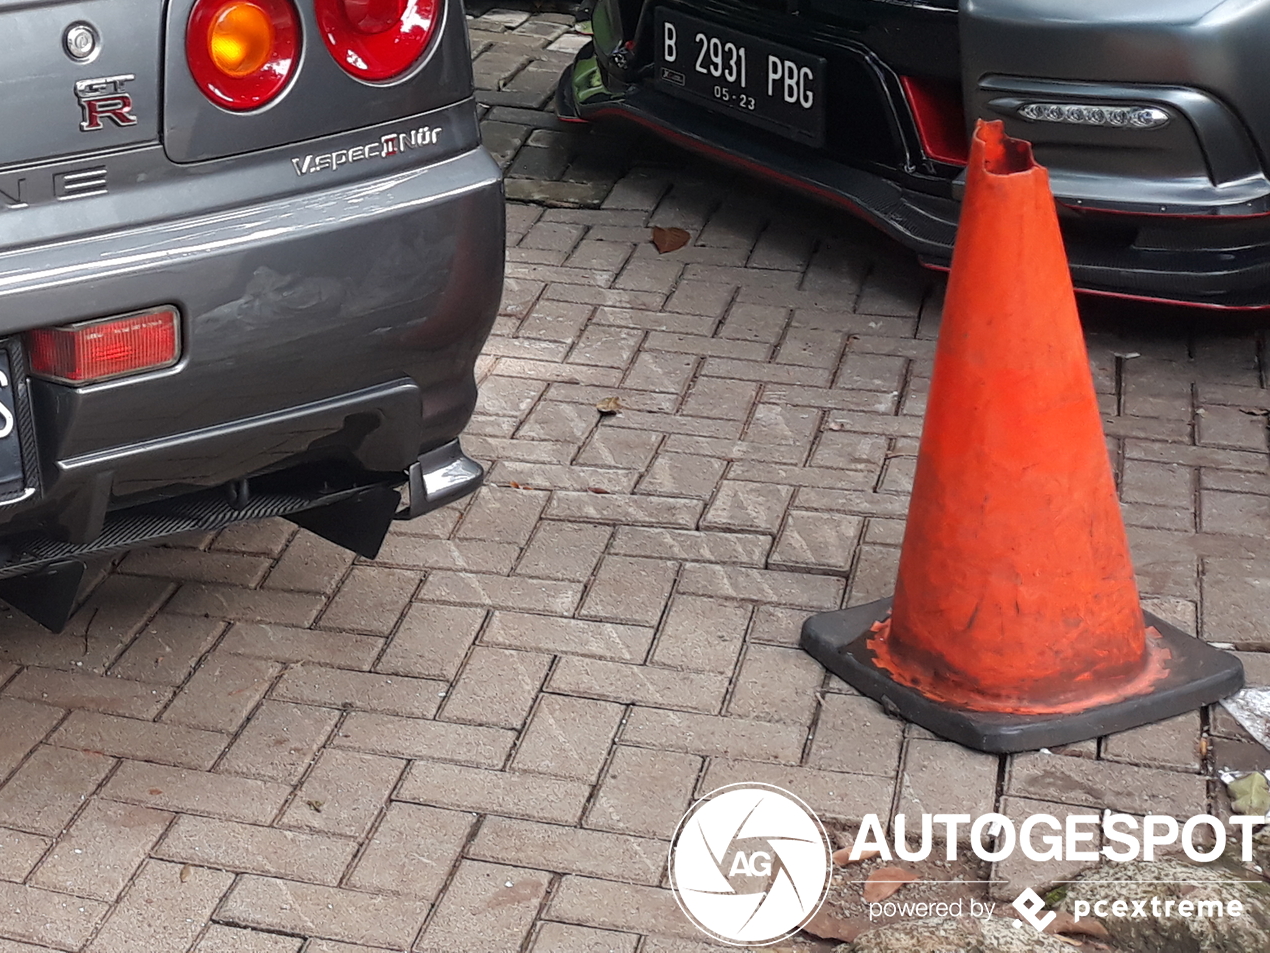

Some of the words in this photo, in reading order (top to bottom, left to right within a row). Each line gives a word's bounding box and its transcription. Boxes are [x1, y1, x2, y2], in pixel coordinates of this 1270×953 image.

[664, 22, 677, 62] B
[695, 33, 746, 88] 2931
[767, 55, 814, 109] PBG
[714, 86, 756, 111] 05-23
